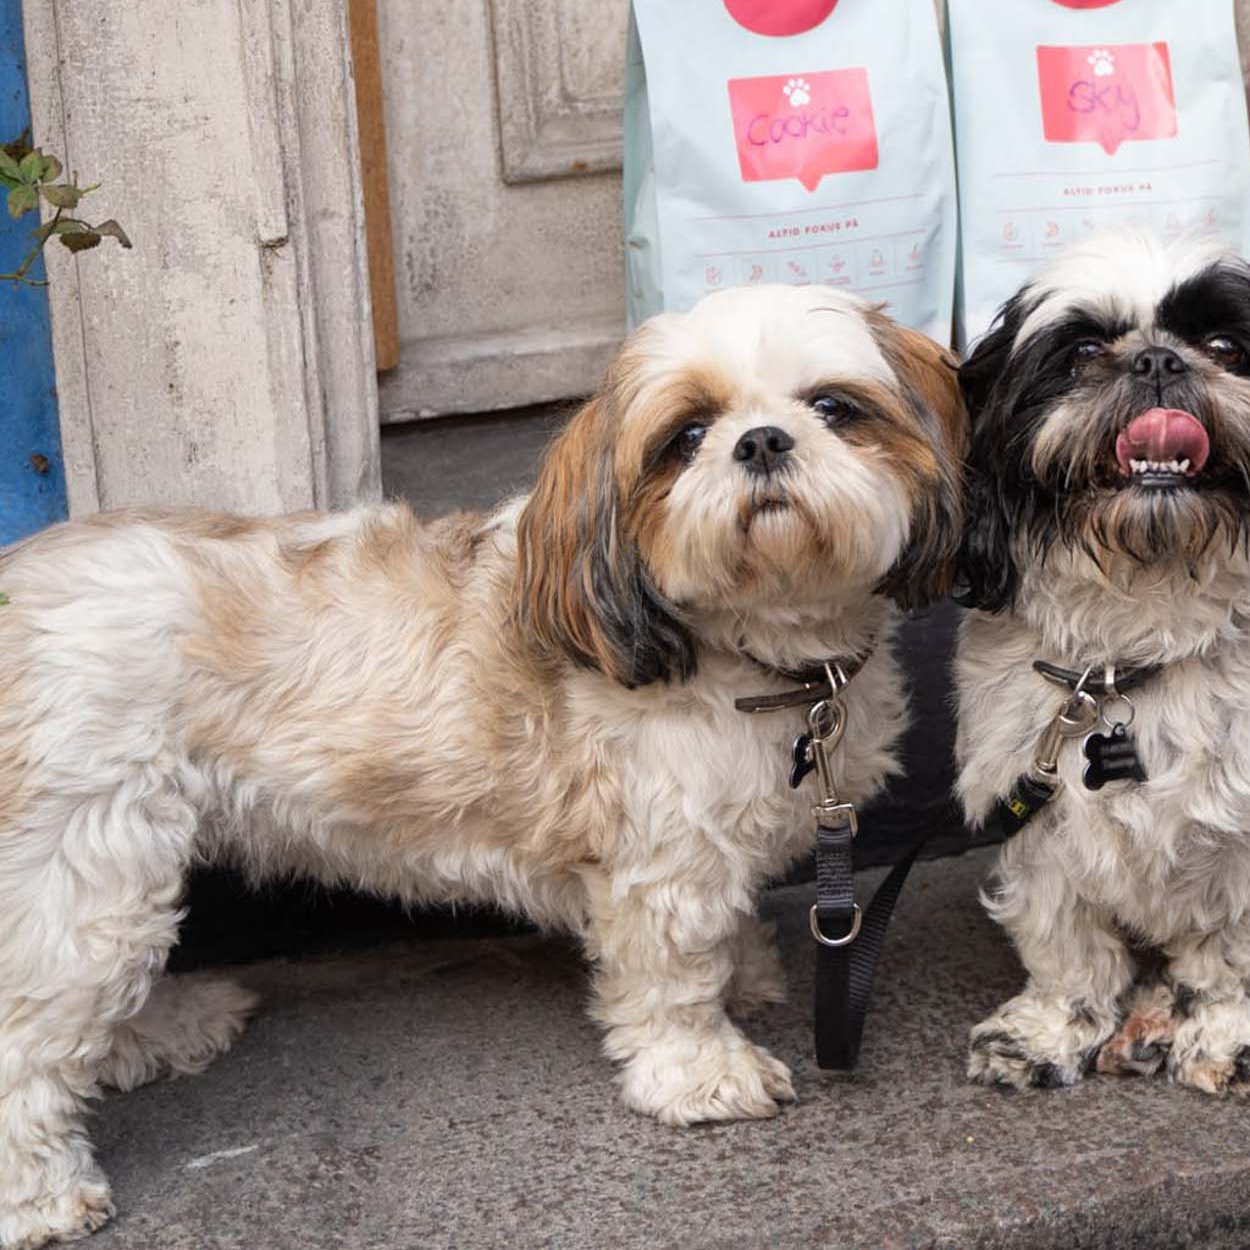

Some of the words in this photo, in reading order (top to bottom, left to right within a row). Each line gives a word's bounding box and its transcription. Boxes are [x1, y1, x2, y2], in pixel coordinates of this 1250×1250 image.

[1067, 80, 1141, 131] Sky
[747, 106, 850, 146] Cookie
[768, 228, 801, 239] ALTID
[805, 223, 841, 234] FOKUS
